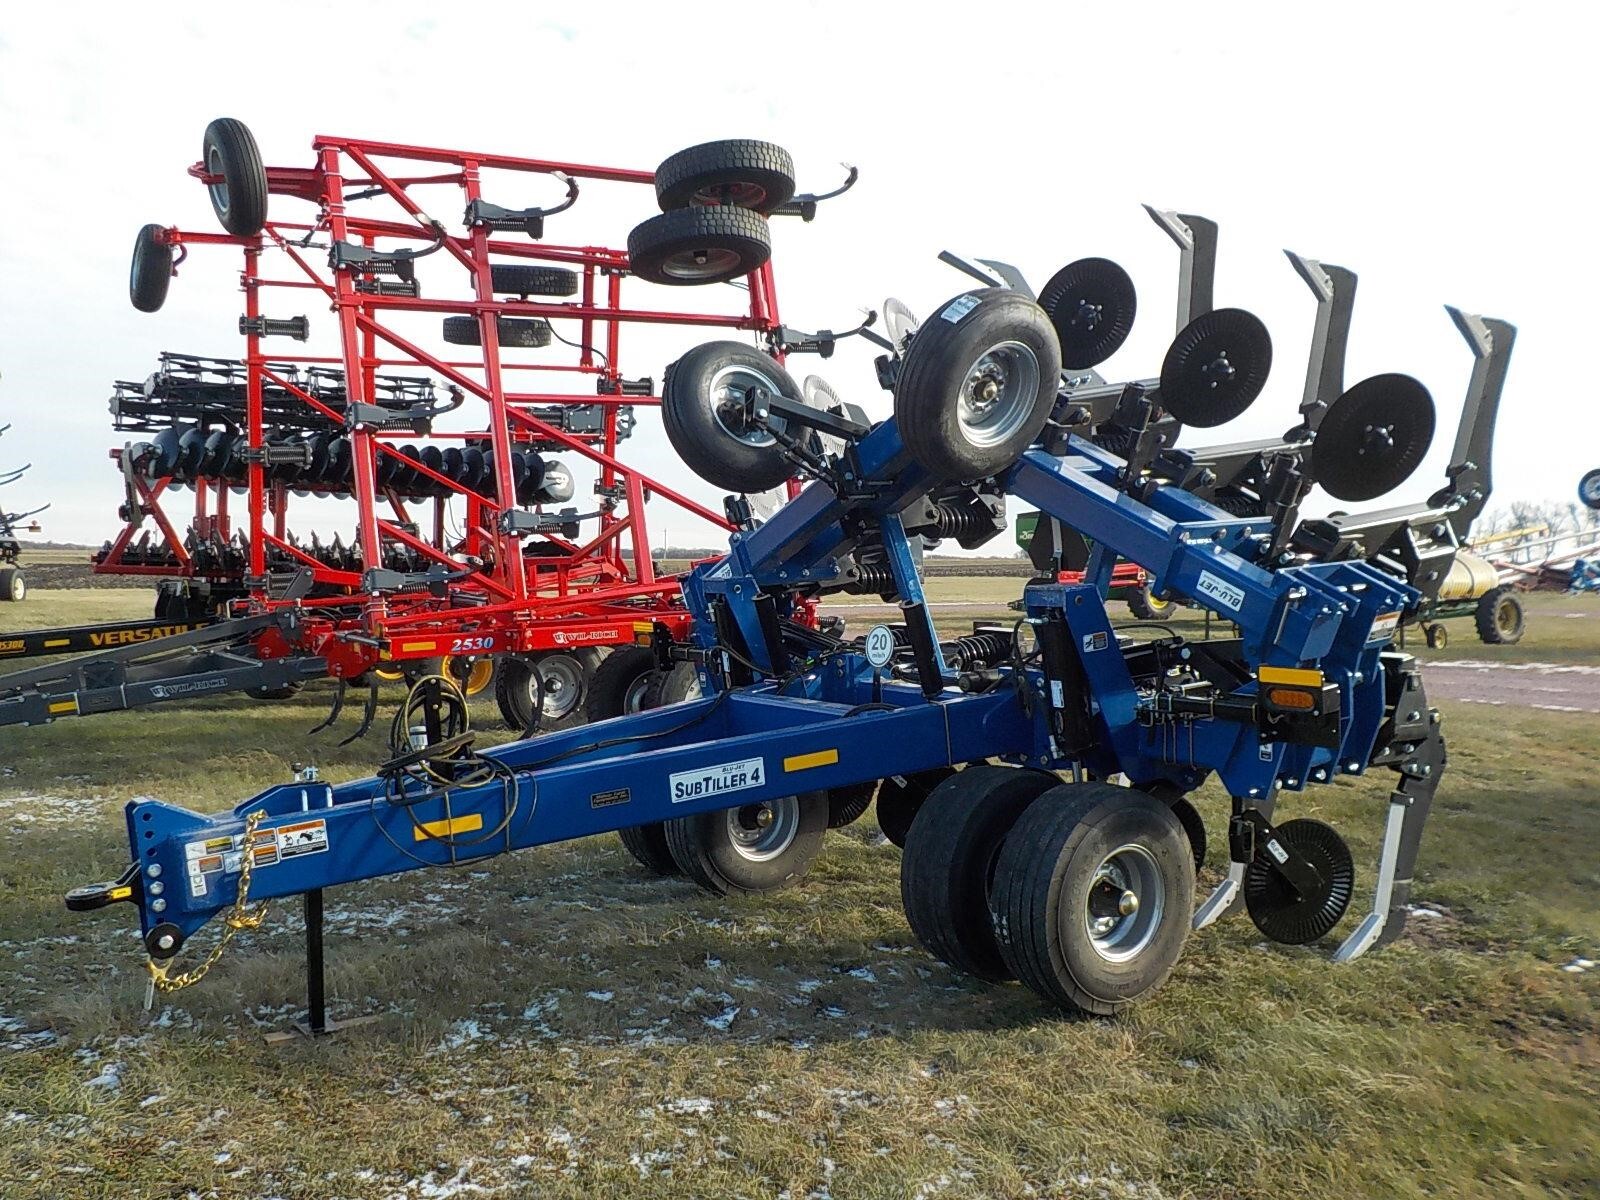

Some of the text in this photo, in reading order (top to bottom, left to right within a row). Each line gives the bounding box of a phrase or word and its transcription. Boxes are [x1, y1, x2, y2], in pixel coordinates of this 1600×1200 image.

[1199, 579, 1242, 608] BLU-JET
[451, 636, 494, 652] 2530
[871, 633, 887, 650] 20
[750, 767, 760, 783] 4
